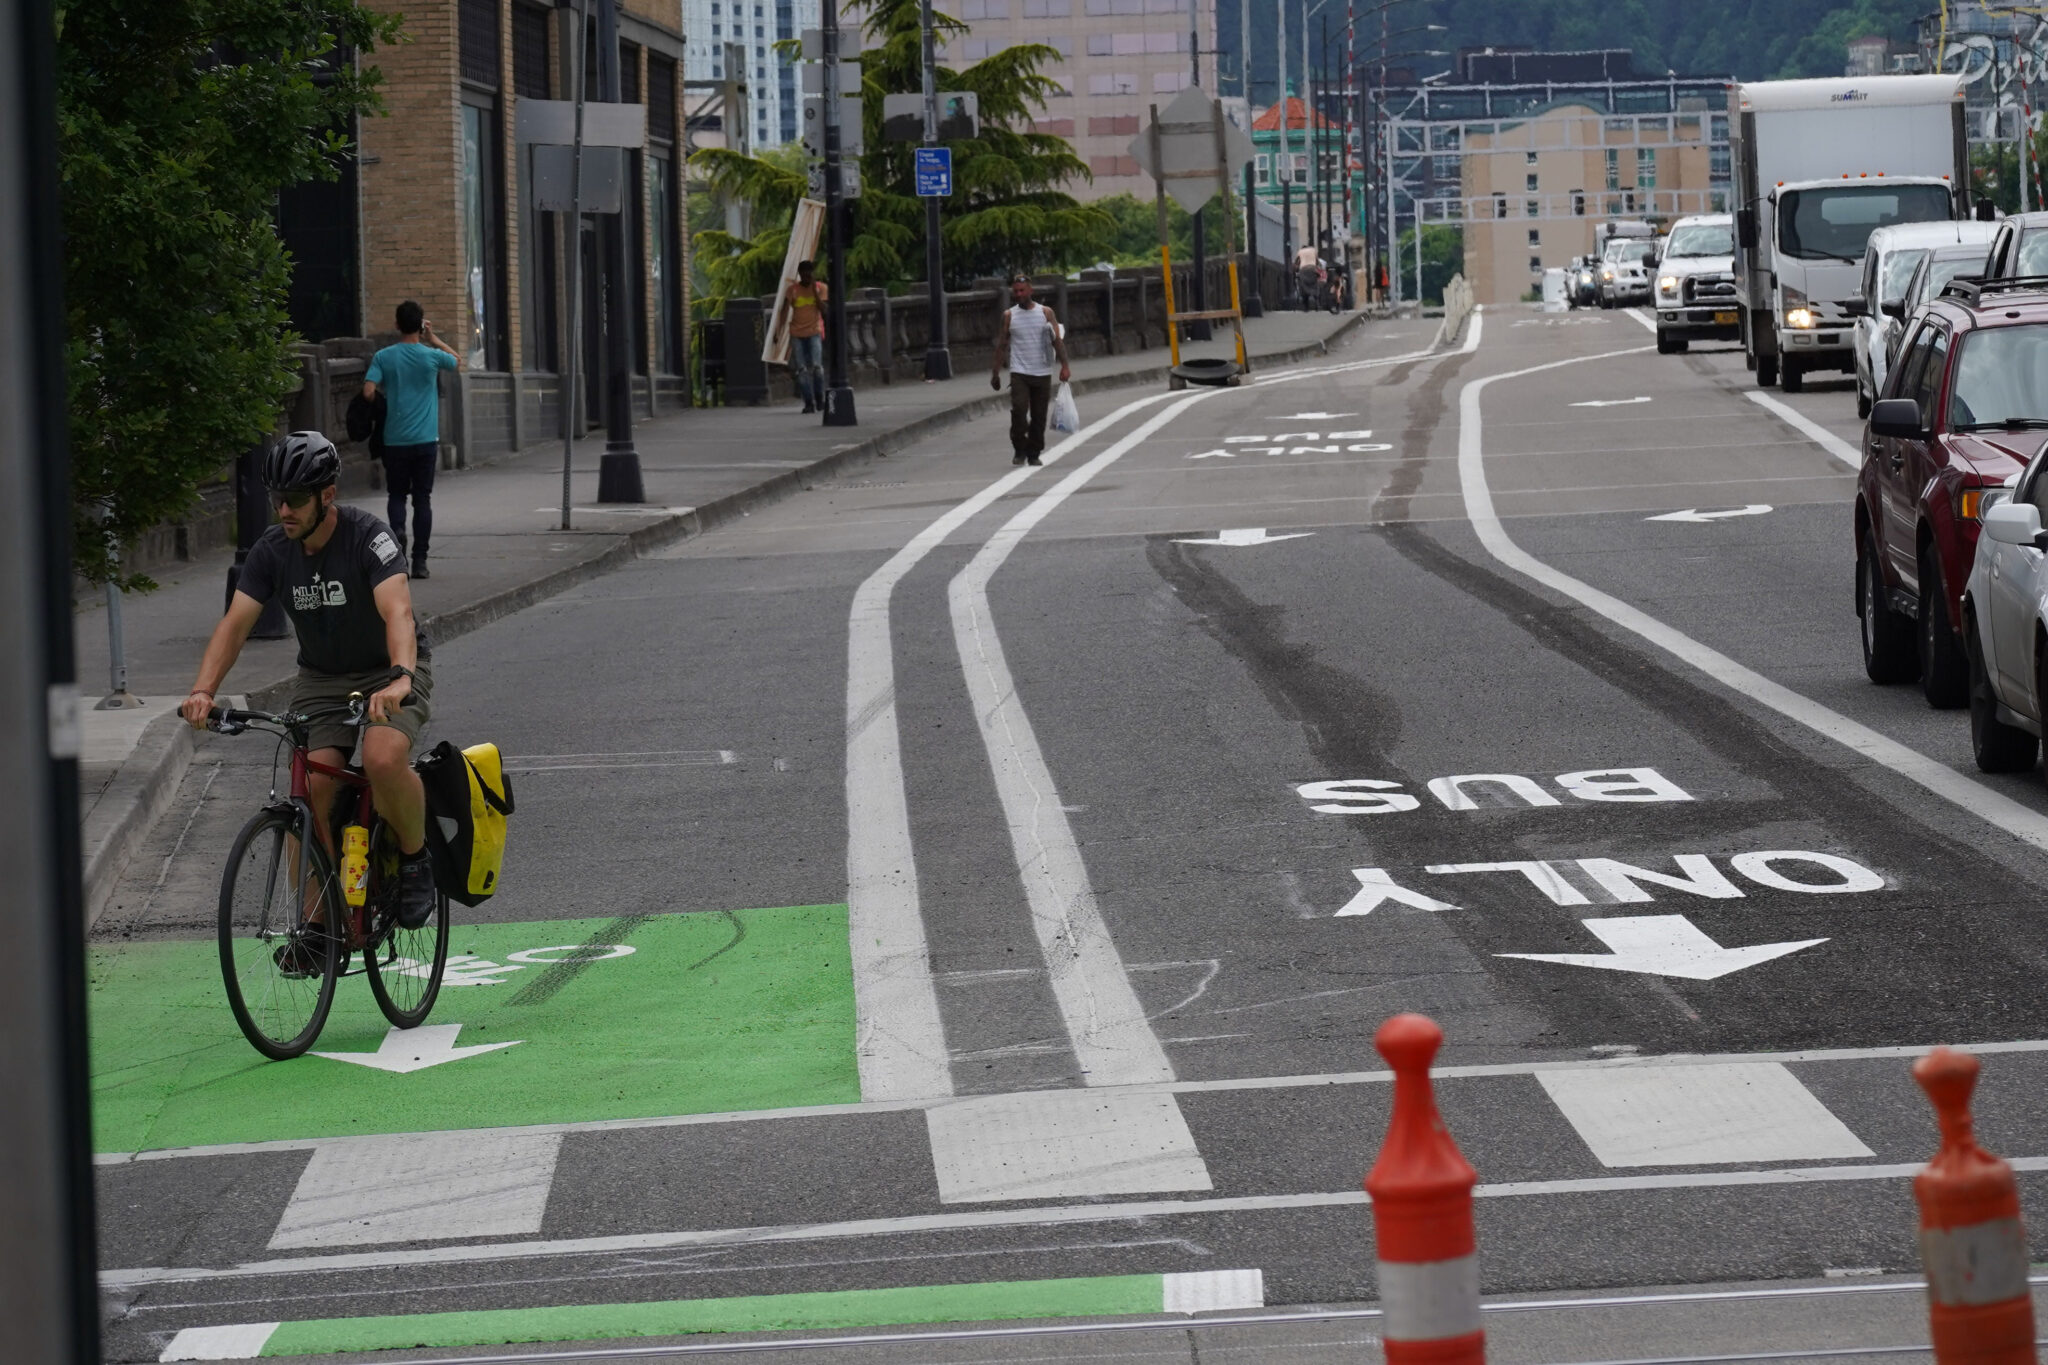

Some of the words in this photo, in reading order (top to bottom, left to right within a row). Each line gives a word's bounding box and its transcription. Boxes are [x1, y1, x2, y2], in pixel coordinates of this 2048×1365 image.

[1830, 89, 1868, 102] SUMMIT
[1223, 430, 1373, 443] BUS
[1186, 443, 1393, 460] ONLY
[292, 585, 320, 597] WILD
[319, 580, 348, 606] 12
[294, 600, 322, 611] GAMES
[1297, 767, 1696, 815] BUS
[1333, 849, 1887, 918] ONLY
